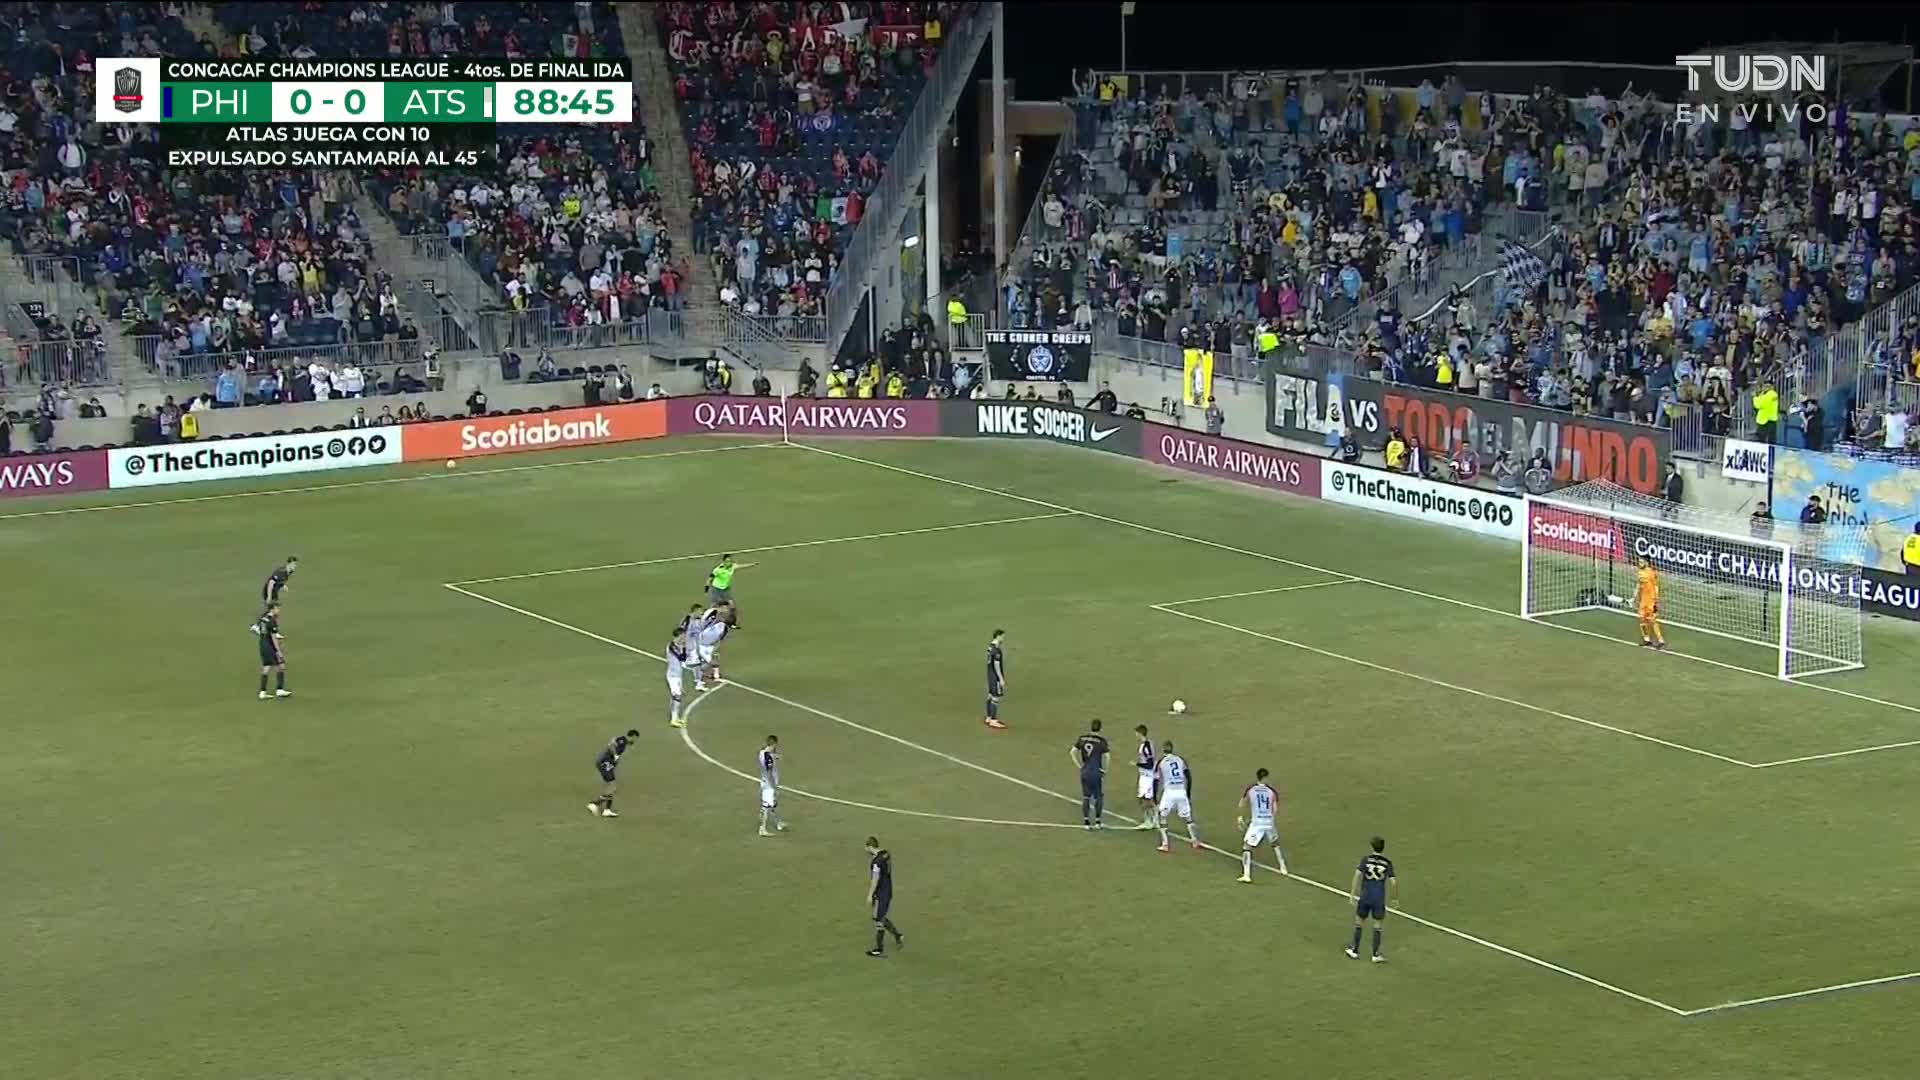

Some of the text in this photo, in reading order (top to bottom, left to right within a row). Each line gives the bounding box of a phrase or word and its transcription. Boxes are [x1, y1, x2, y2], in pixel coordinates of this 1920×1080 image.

[986, 333, 1007, 343] THE
[694, 402, 908, 430] QATAR AIRWAYS
[977, 404, 1085, 442] NIKE SOCCER
[460, 413, 612, 451] Scotiabank
[125, 441, 325, 476] @TheChampions
[1159, 434, 1301, 487] QATAR AIRWAYS
[1331, 469, 1467, 517] @TheChampions
[1634, 537, 1714, 569] Concacaf
[1718, 552, 1841, 594] CHAMIONS
[1084, 743, 1095, 757] 9
[1169, 762, 1181, 777] 2
[1256, 794, 1270, 810] 14
[1365, 864, 1387, 881] 33
